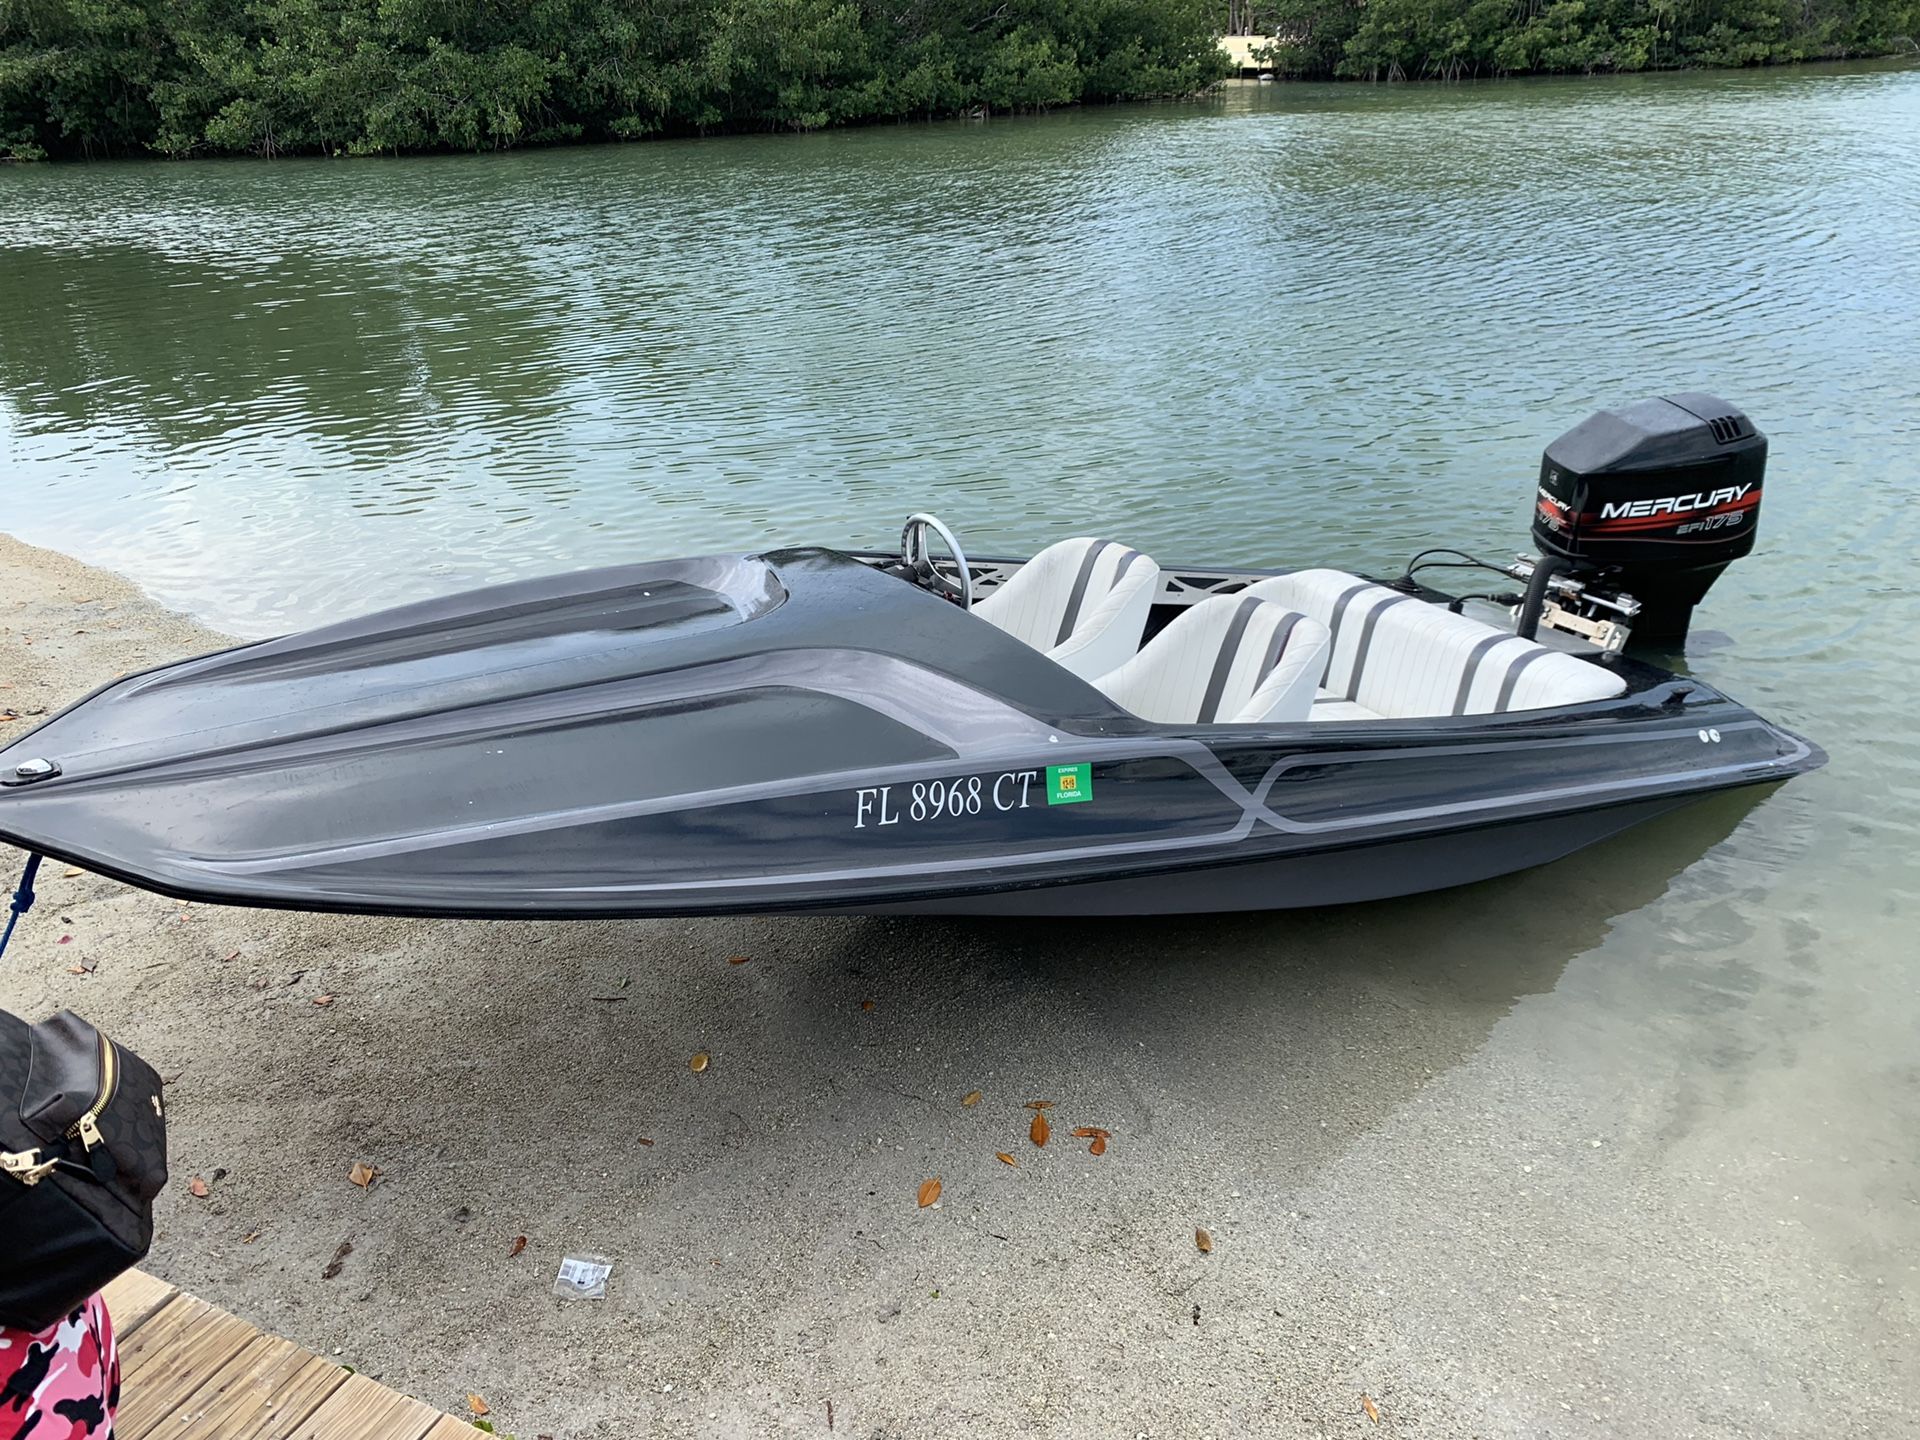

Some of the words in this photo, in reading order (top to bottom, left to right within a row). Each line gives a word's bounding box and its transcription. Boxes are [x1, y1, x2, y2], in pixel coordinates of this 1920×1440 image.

[1538, 485, 1571, 512] MERCURY
[1600, 482, 1752, 519] MERCURY
[853, 786, 900, 829] FL
[909, 776, 982, 822] 8968
[992, 770, 1037, 812] CT
[1056, 790, 1082, 799] FLORIDA
